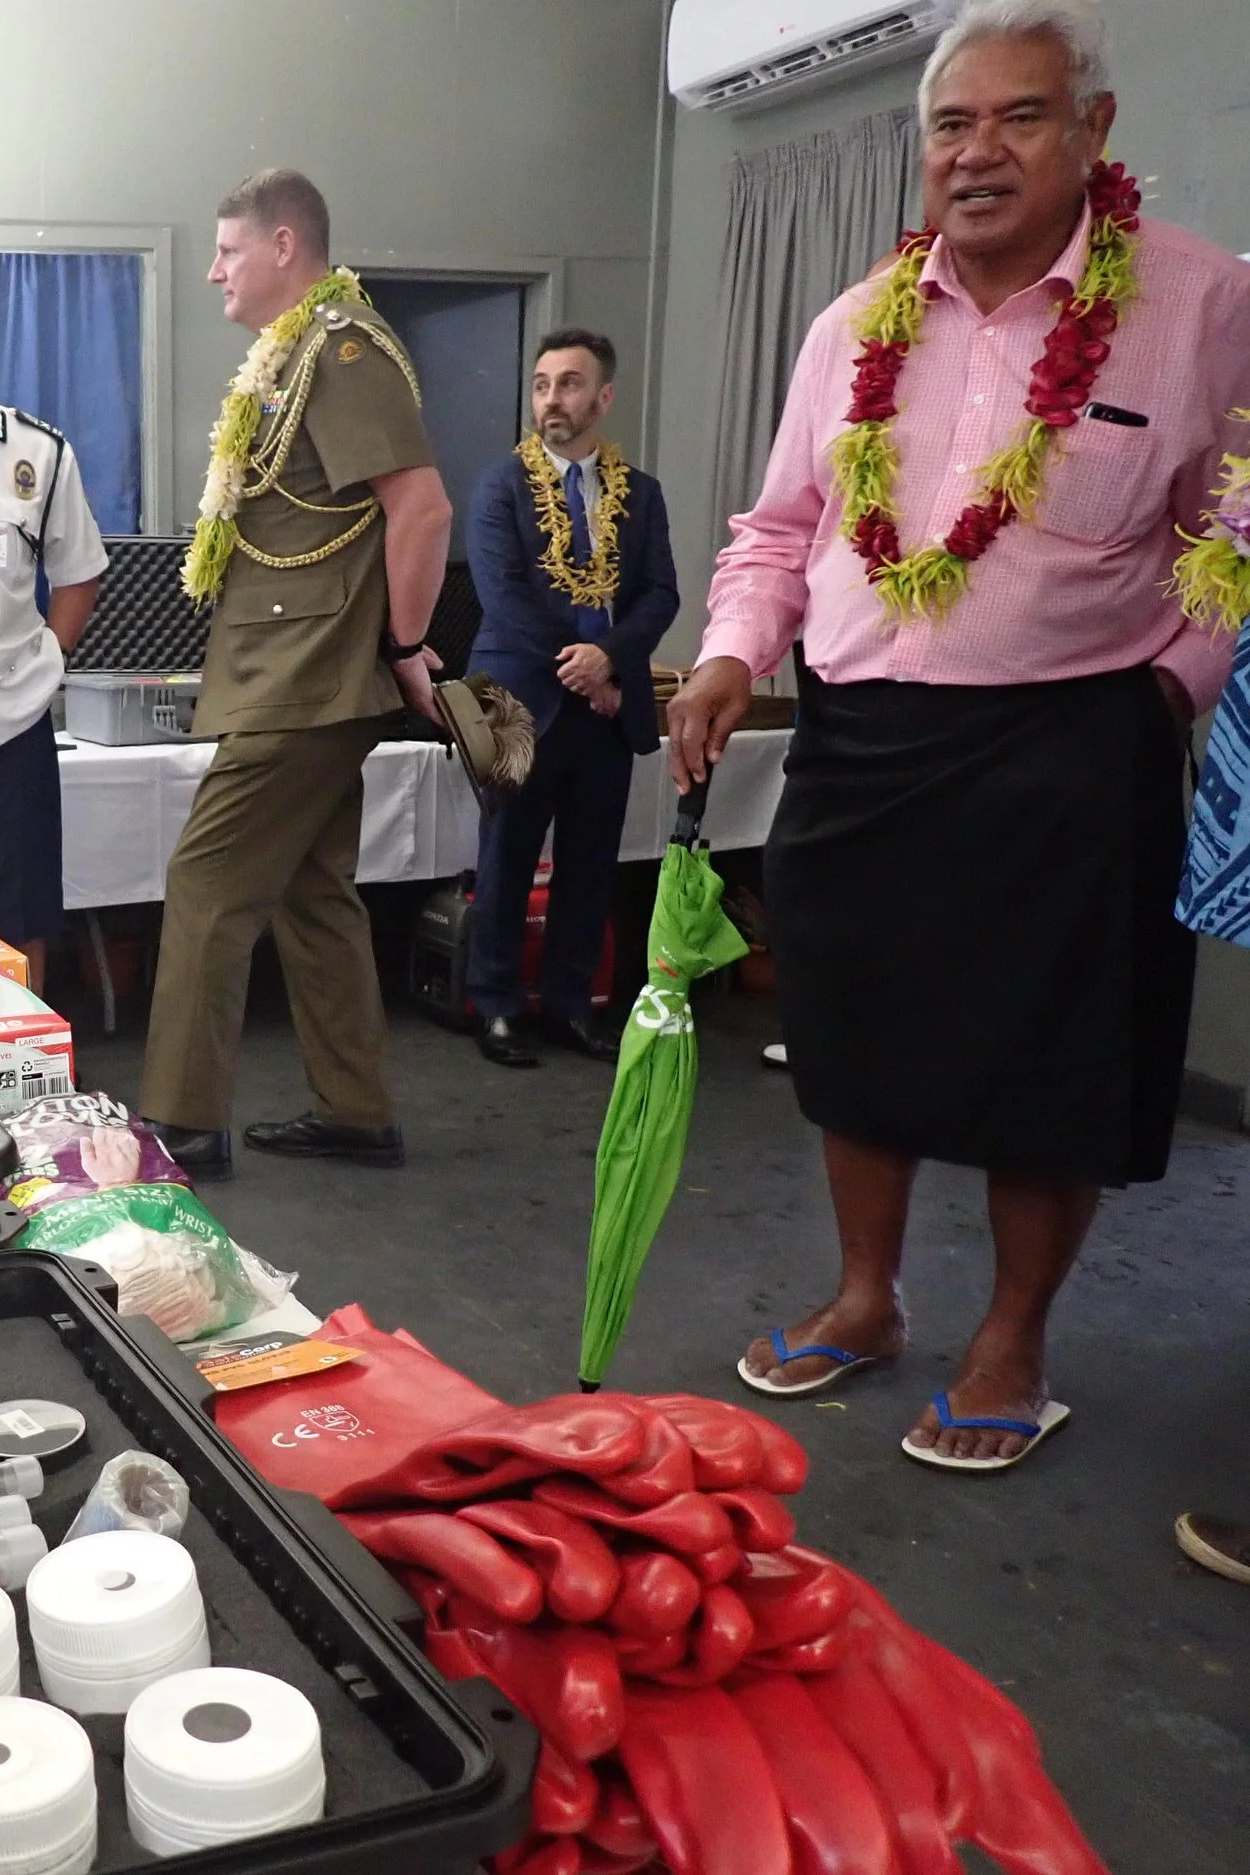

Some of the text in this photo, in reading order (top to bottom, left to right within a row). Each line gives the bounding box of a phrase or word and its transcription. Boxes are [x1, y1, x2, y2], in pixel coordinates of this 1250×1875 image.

[18, 1038, 45, 1047] LARGE
[174, 1205, 216, 1238] WRIST
[300, 1408, 321, 1418] EN
[271, 1423, 320, 1448] CE
